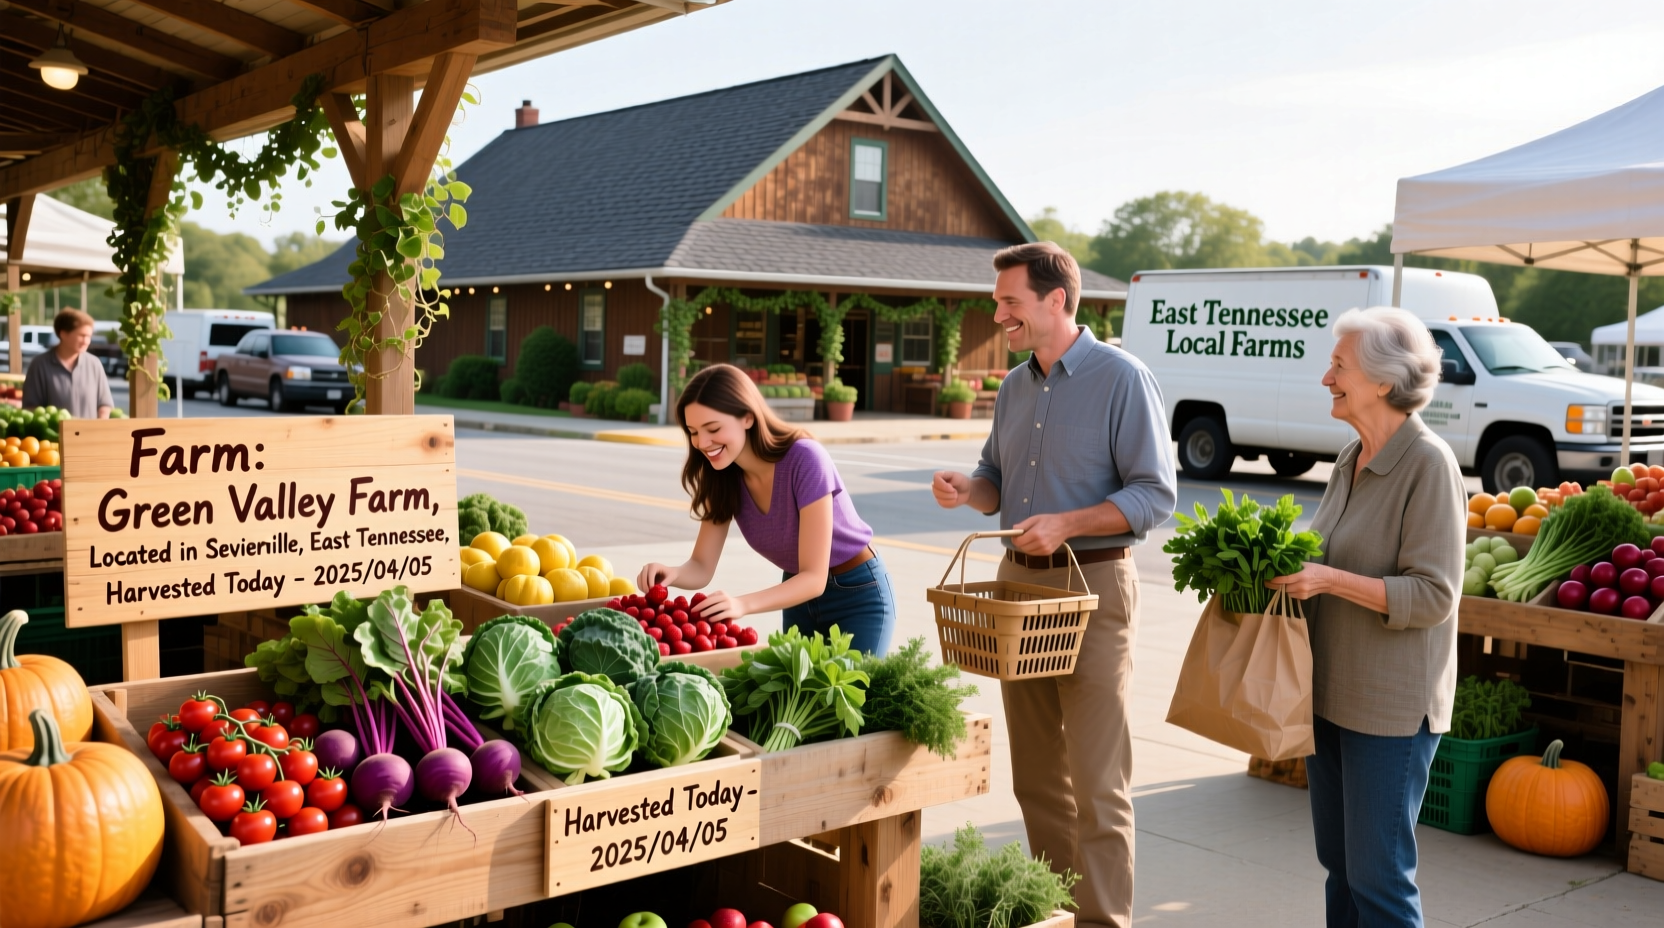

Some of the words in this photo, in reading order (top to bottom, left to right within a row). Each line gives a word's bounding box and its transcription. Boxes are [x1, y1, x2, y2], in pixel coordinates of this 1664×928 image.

[1149, 299, 1198, 325] East
[1203, 299, 1329, 328] Tennessee
[1165, 329, 1226, 356] Local
[1229, 330, 1306, 360] Farms
[129, 427, 265, 478] Farm:
[97, 487, 214, 533] Green
[227, 481, 336, 529] Valley
[348, 476, 440, 517] Farm,
[89, 540, 172, 569] Located
[180, 541, 198, 562] in
[310, 530, 351, 551] East
[355, 527, 450, 547] Tennessee,
[106, 572, 216, 606] Harvested
[223, 569, 286, 599] Today
[313, 555, 432, 586] 2025/04/05
[564, 787, 675, 837] Harvested
[590, 817, 729, 872] 2025/04/05
